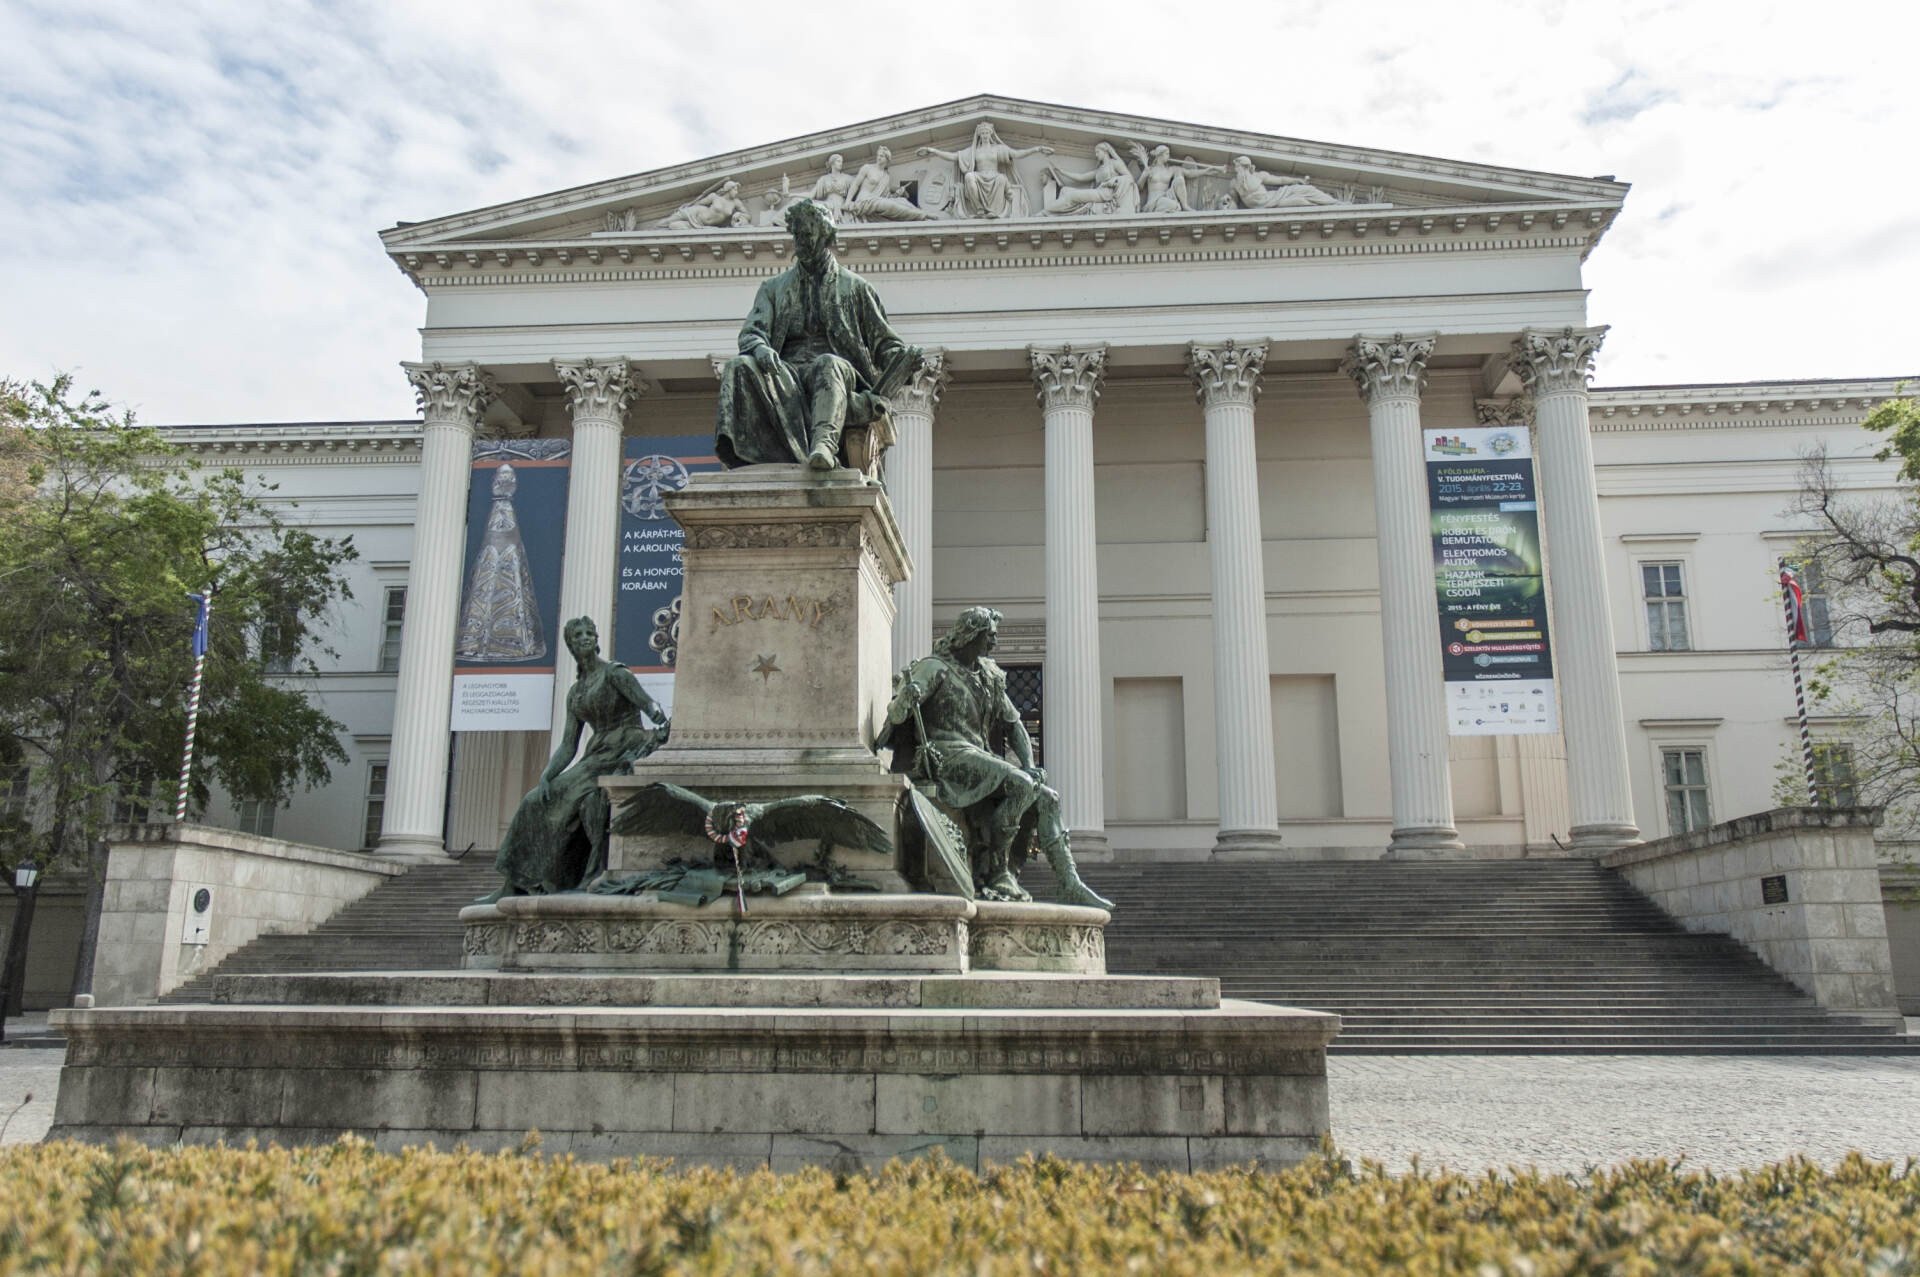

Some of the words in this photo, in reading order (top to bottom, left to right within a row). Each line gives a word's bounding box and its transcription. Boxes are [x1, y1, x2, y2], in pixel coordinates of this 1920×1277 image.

[1446, 473, 1524, 482] TUDOMÁNYFESZTIVÁL
[1439, 484, 1464, 493] 2015.
[1492, 482, 1524, 492] 22-23.
[1440, 513, 1500, 524] FÉNYFESTÉS
[624, 531, 632, 539] A
[634, 529, 686, 539] KÁRPÁT-ME
[1442, 528, 1472, 536] ROBOT
[624, 544, 631, 552] A
[1443, 548, 1507, 558] ELEKTROMOS
[1444, 556, 1477, 566] AUTÓK
[622, 566, 632, 576] ÉS
[634, 568, 642, 576] A
[1445, 569, 1485, 579] HAZÁNK
[622, 580, 668, 590] KORÁBAN
[1446, 577, 1504, 588] TERMÉSZETI
[1446, 587, 1480, 597] CSODÁI
[711, 594, 834, 635] ARANY
